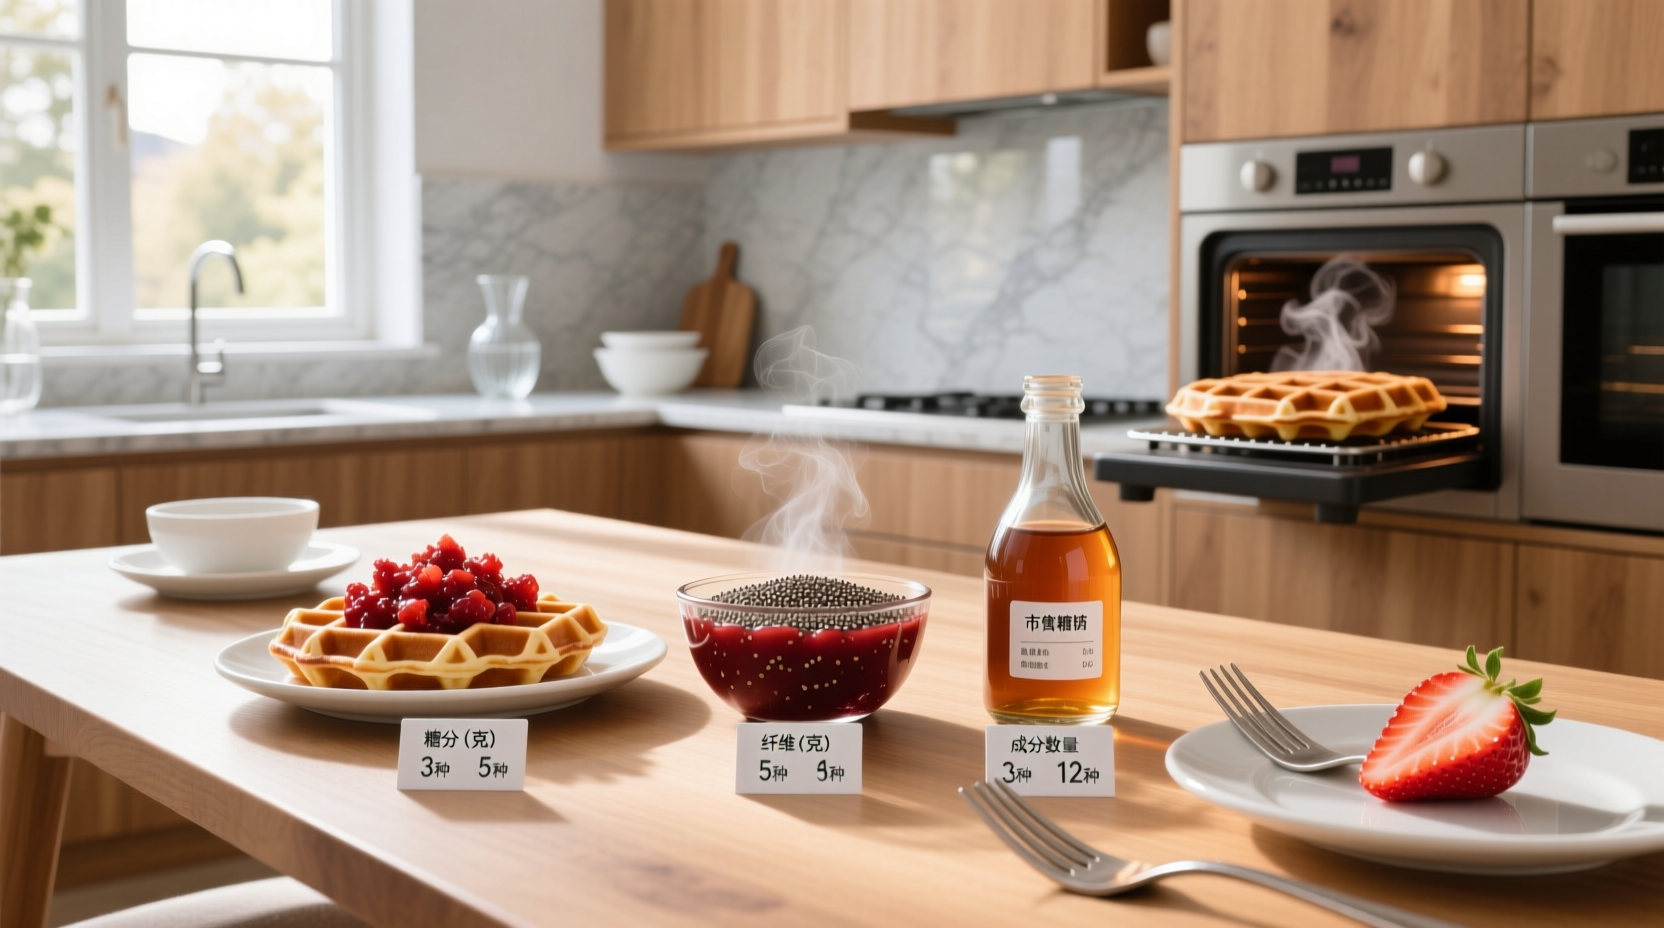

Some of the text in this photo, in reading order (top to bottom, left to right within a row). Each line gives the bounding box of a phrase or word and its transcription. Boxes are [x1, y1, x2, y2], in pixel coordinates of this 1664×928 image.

[1011, 734, 1079, 753] 成分数量
[420, 756, 509, 779] 3种 5种
[759, 759, 788, 782] 5种
[1002, 760, 1100, 784] 3种 12种
